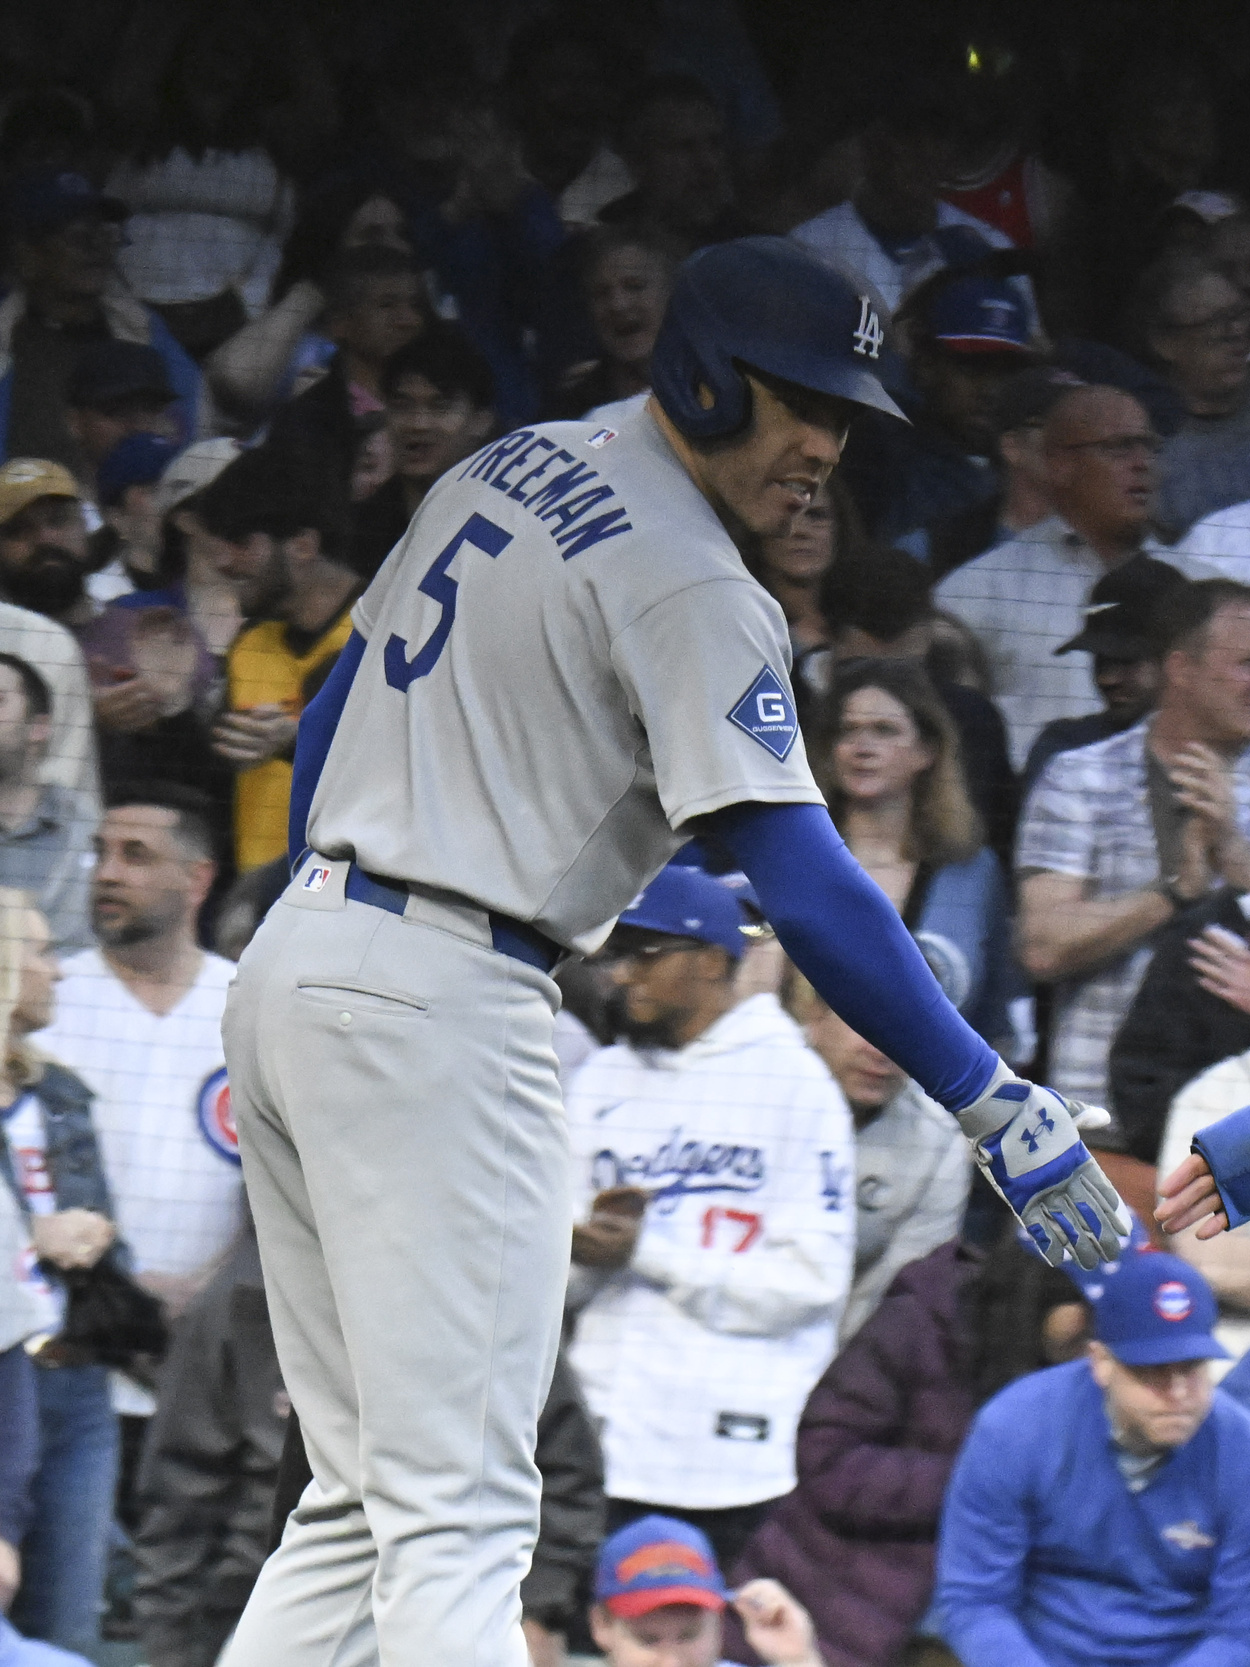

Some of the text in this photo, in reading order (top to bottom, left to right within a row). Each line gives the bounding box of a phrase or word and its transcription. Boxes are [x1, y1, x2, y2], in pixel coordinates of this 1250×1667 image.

[853, 295, 884, 359] LA
[384, 512, 514, 694] 5
[756, 692, 786, 723] G
[700, 1206, 764, 1253] 17
